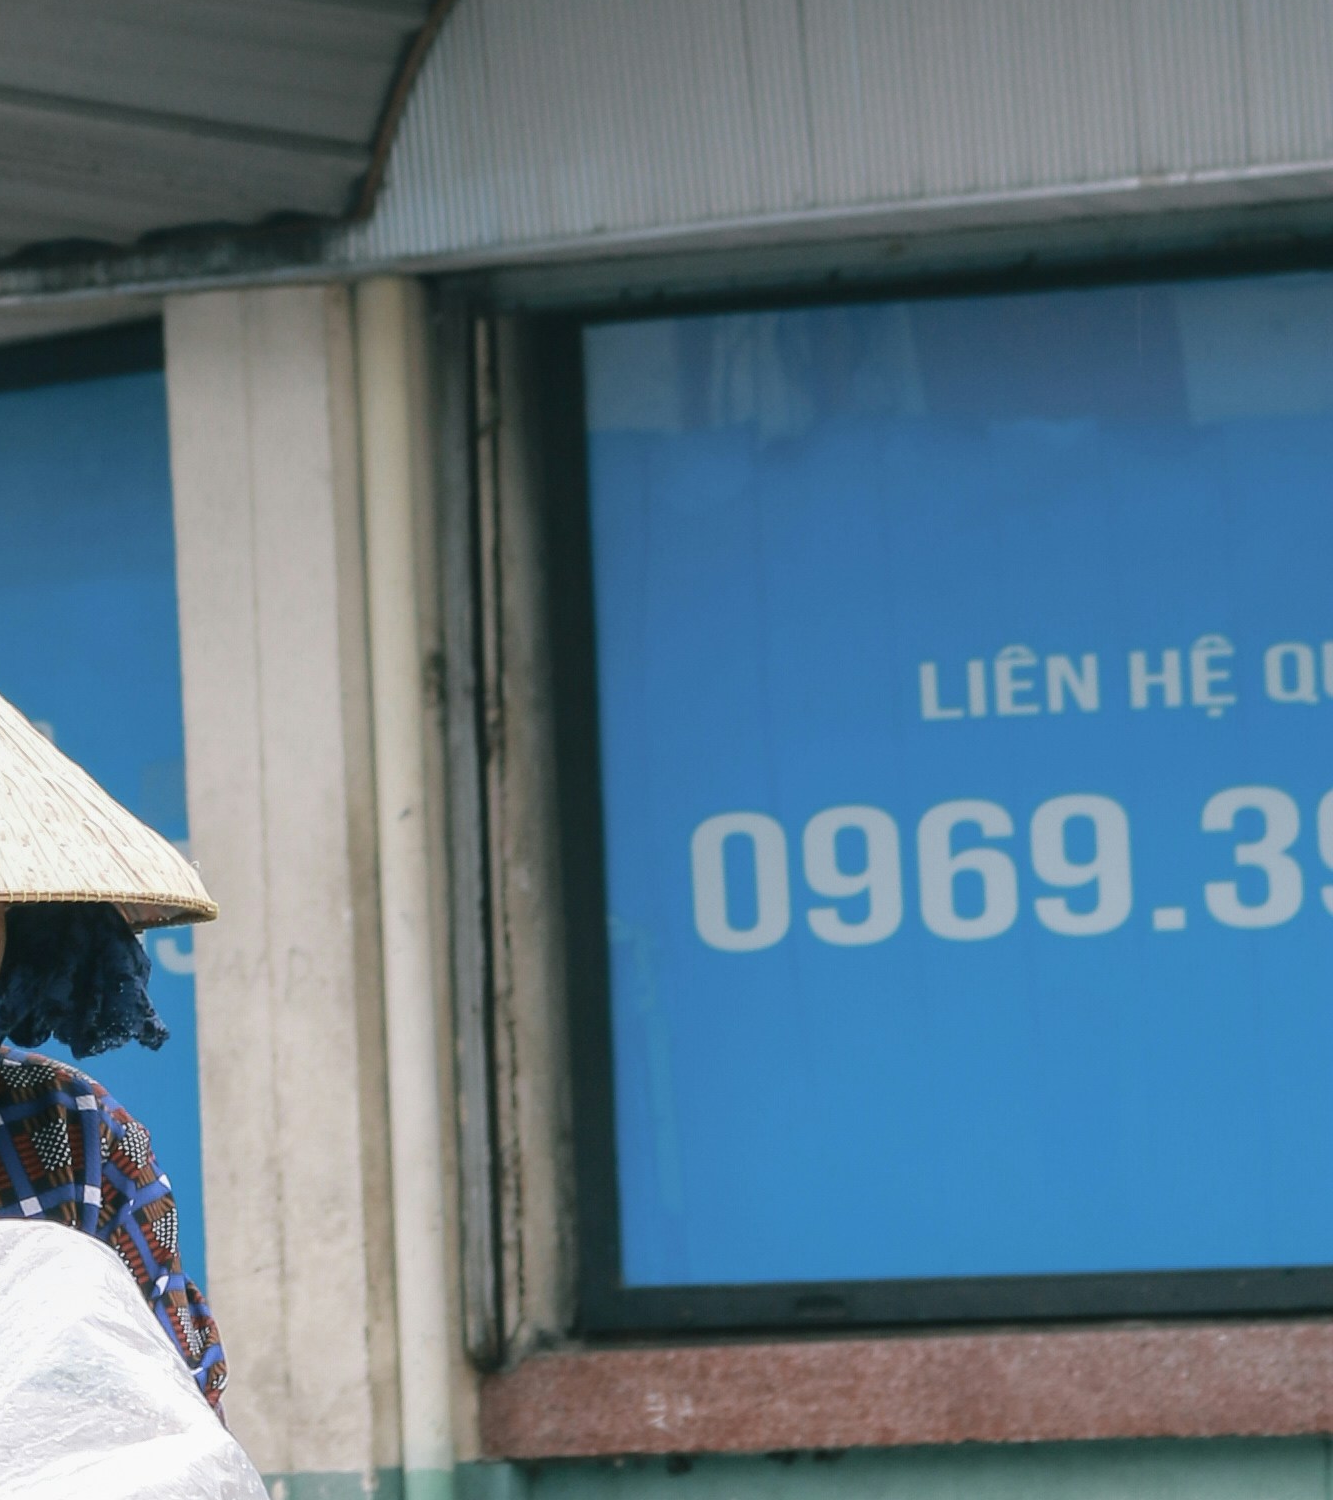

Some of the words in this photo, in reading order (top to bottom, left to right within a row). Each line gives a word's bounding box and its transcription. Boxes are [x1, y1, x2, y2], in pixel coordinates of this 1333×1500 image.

[919, 644, 1100, 721] LIÊN
[1129, 635, 1236, 719] HỆ
[1264, 640, 1333, 705] Q
[690, 784, 1333, 953] 0969.3
